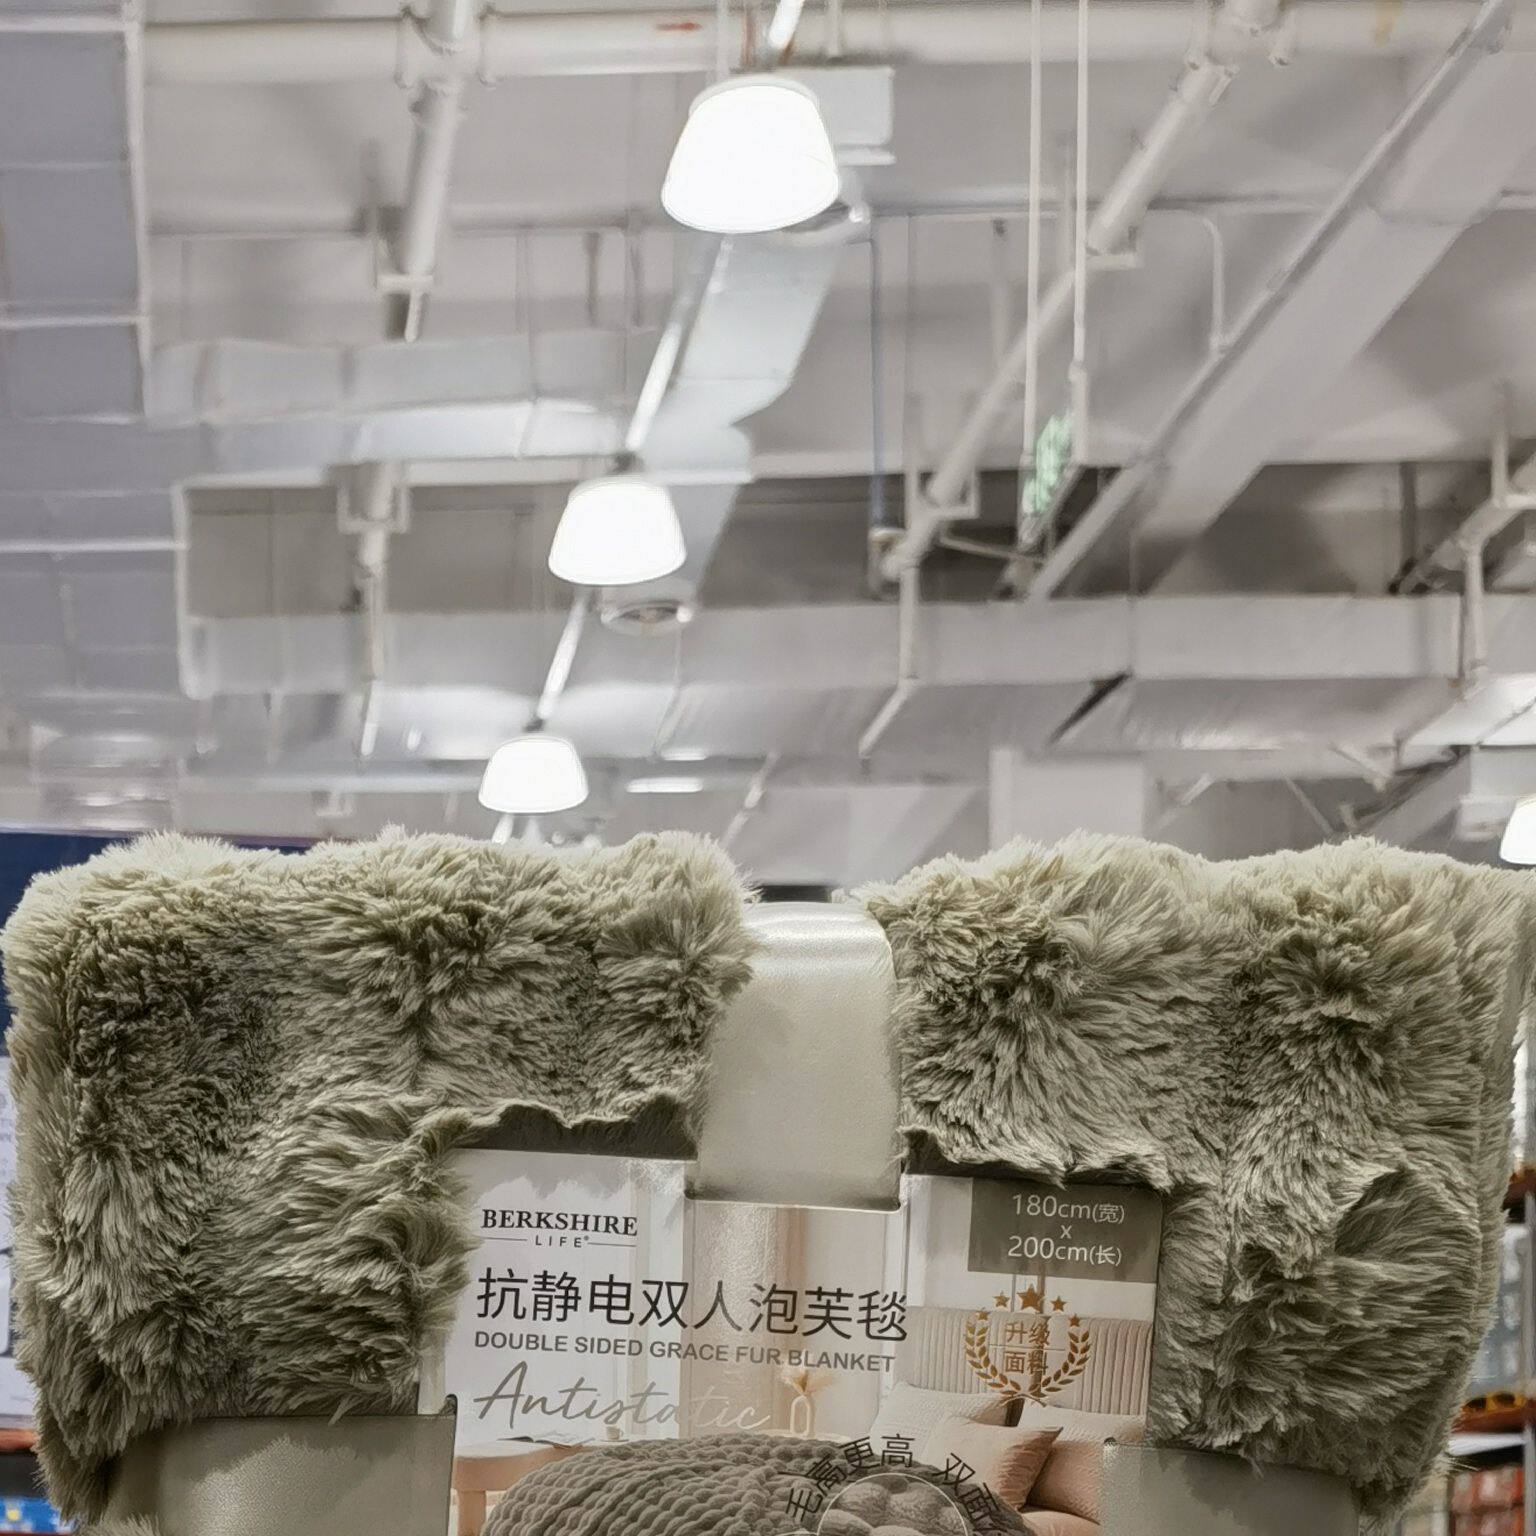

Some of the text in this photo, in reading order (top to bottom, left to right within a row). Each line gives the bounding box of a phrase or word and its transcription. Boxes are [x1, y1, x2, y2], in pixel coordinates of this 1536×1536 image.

[481, 1208, 638, 1237] BERKSHIRE
[1012, 1194, 1125, 1225] 180cm(宽)
[1007, 1239, 1122, 1267] 200cm(长)
[476, 1268, 907, 1344] 抗静电双人泡芙毯
[1004, 1320, 1050, 1346] 升级
[474, 1331, 896, 1373] DOUBLE SIDED GRACE FUR BLANKET
[1004, 1350, 1049, 1376] 面料
[473, 1361, 770, 1431] Antistatic
